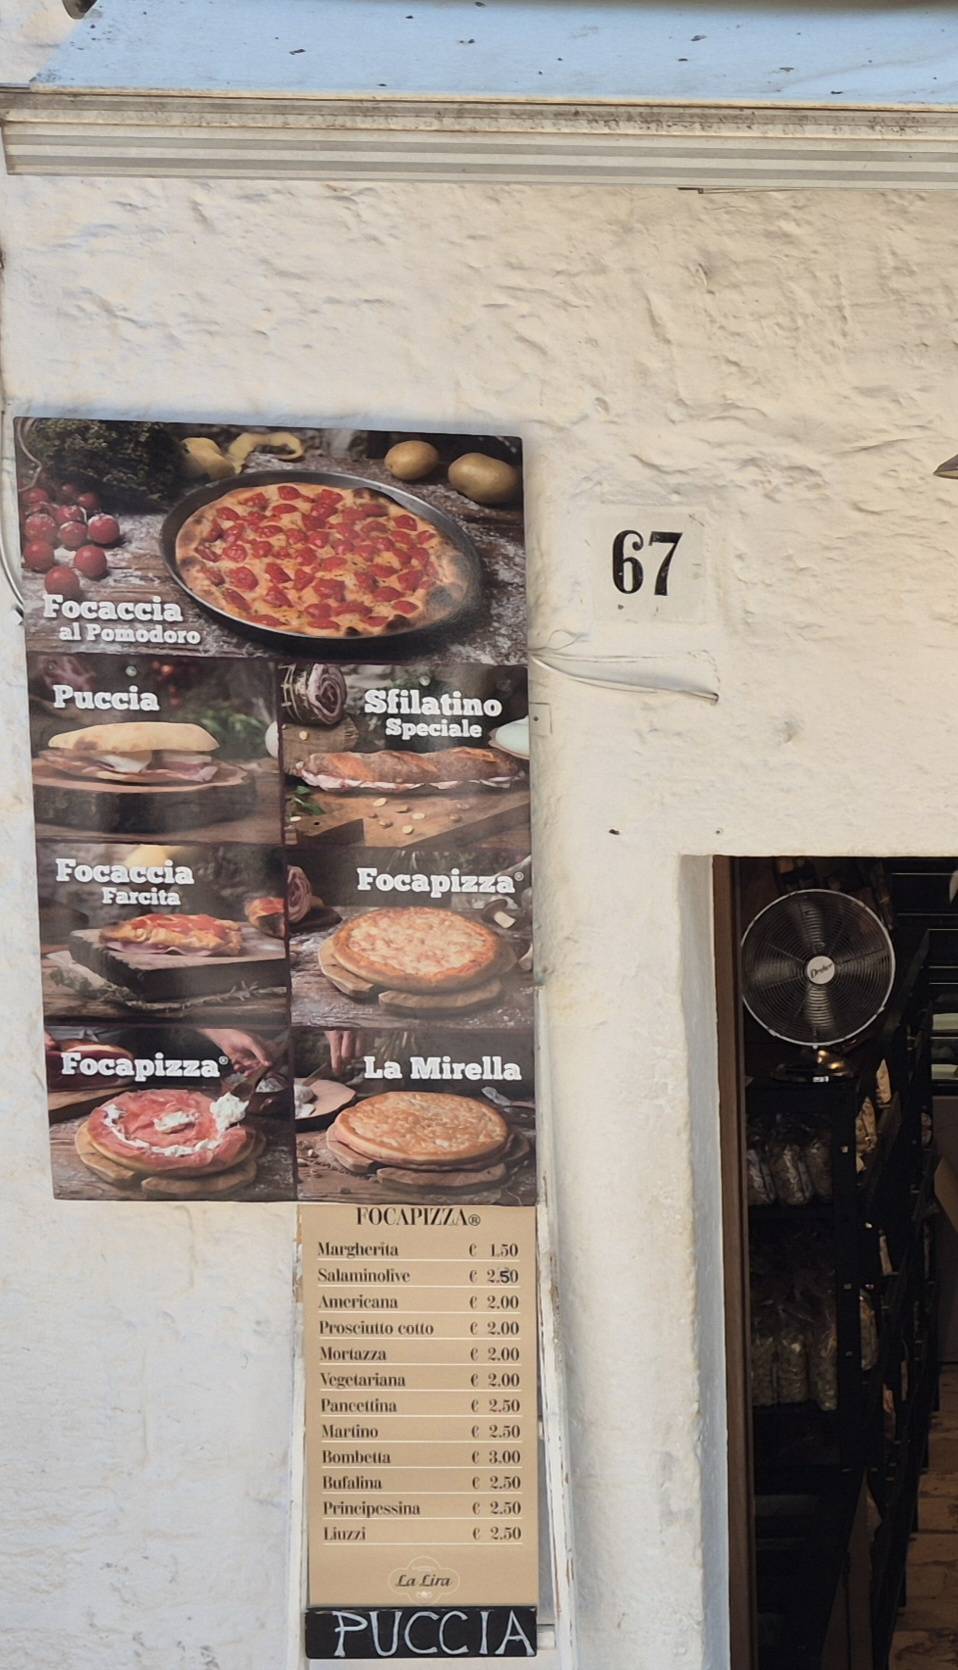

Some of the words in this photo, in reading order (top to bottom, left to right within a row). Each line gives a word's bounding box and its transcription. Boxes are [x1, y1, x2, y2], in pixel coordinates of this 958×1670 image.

[612, 529, 683, 597] 67
[43, 595, 183, 622] Focaccia
[59, 624, 82, 641] al
[86, 623, 200, 645] Pomodoro
[53, 685, 159, 712] Puccia
[364, 690, 502, 718] Sfilatino
[385, 718, 482, 739] Speciale
[56, 858, 194, 885] Focaccia
[102, 887, 181, 906] Farcita
[363, 1056, 402, 1079] La
[409, 1057, 522, 1081] Mirella
[318, 1242, 399, 1258] Margherita
[491, 1243, 518, 1257] 1.50
[317, 1268, 410, 1283] Salaminolive
[318, 1295, 398, 1309] Americana
[487, 1296, 519, 1309] 2.00
[319, 1320, 393, 1335] Prosciutto
[398, 1322, 434, 1335] cotto
[488, 1321, 519, 1335] 2.00
[319, 1346, 386, 1361] Mortazza
[488, 1347, 520, 1361] 2.00
[320, 1372, 406, 1389] Vegetariana
[488, 1373, 520, 1387] 2.00
[321, 1398, 397, 1412] Pancettina
[488, 1399, 520, 1412] 2.50
[322, 1424, 378, 1439] Martino
[489, 1425, 521, 1439] 2.50
[322, 1450, 391, 1464] Bombetta
[489, 1450, 521, 1464] 3.00
[322, 1476, 382, 1490] Bufalina
[490, 1476, 521, 1490] 2.50
[323, 1501, 420, 1518] Principessina
[490, 1501, 521, 1515] 2.50
[323, 1526, 367, 1541] Liuzzi
[490, 1526, 522, 1540] 2.50
[395, 1574, 416, 1587] La
[419, 1574, 451, 1587] Lira
[332, 1610, 536, 1657] PUCCIA
